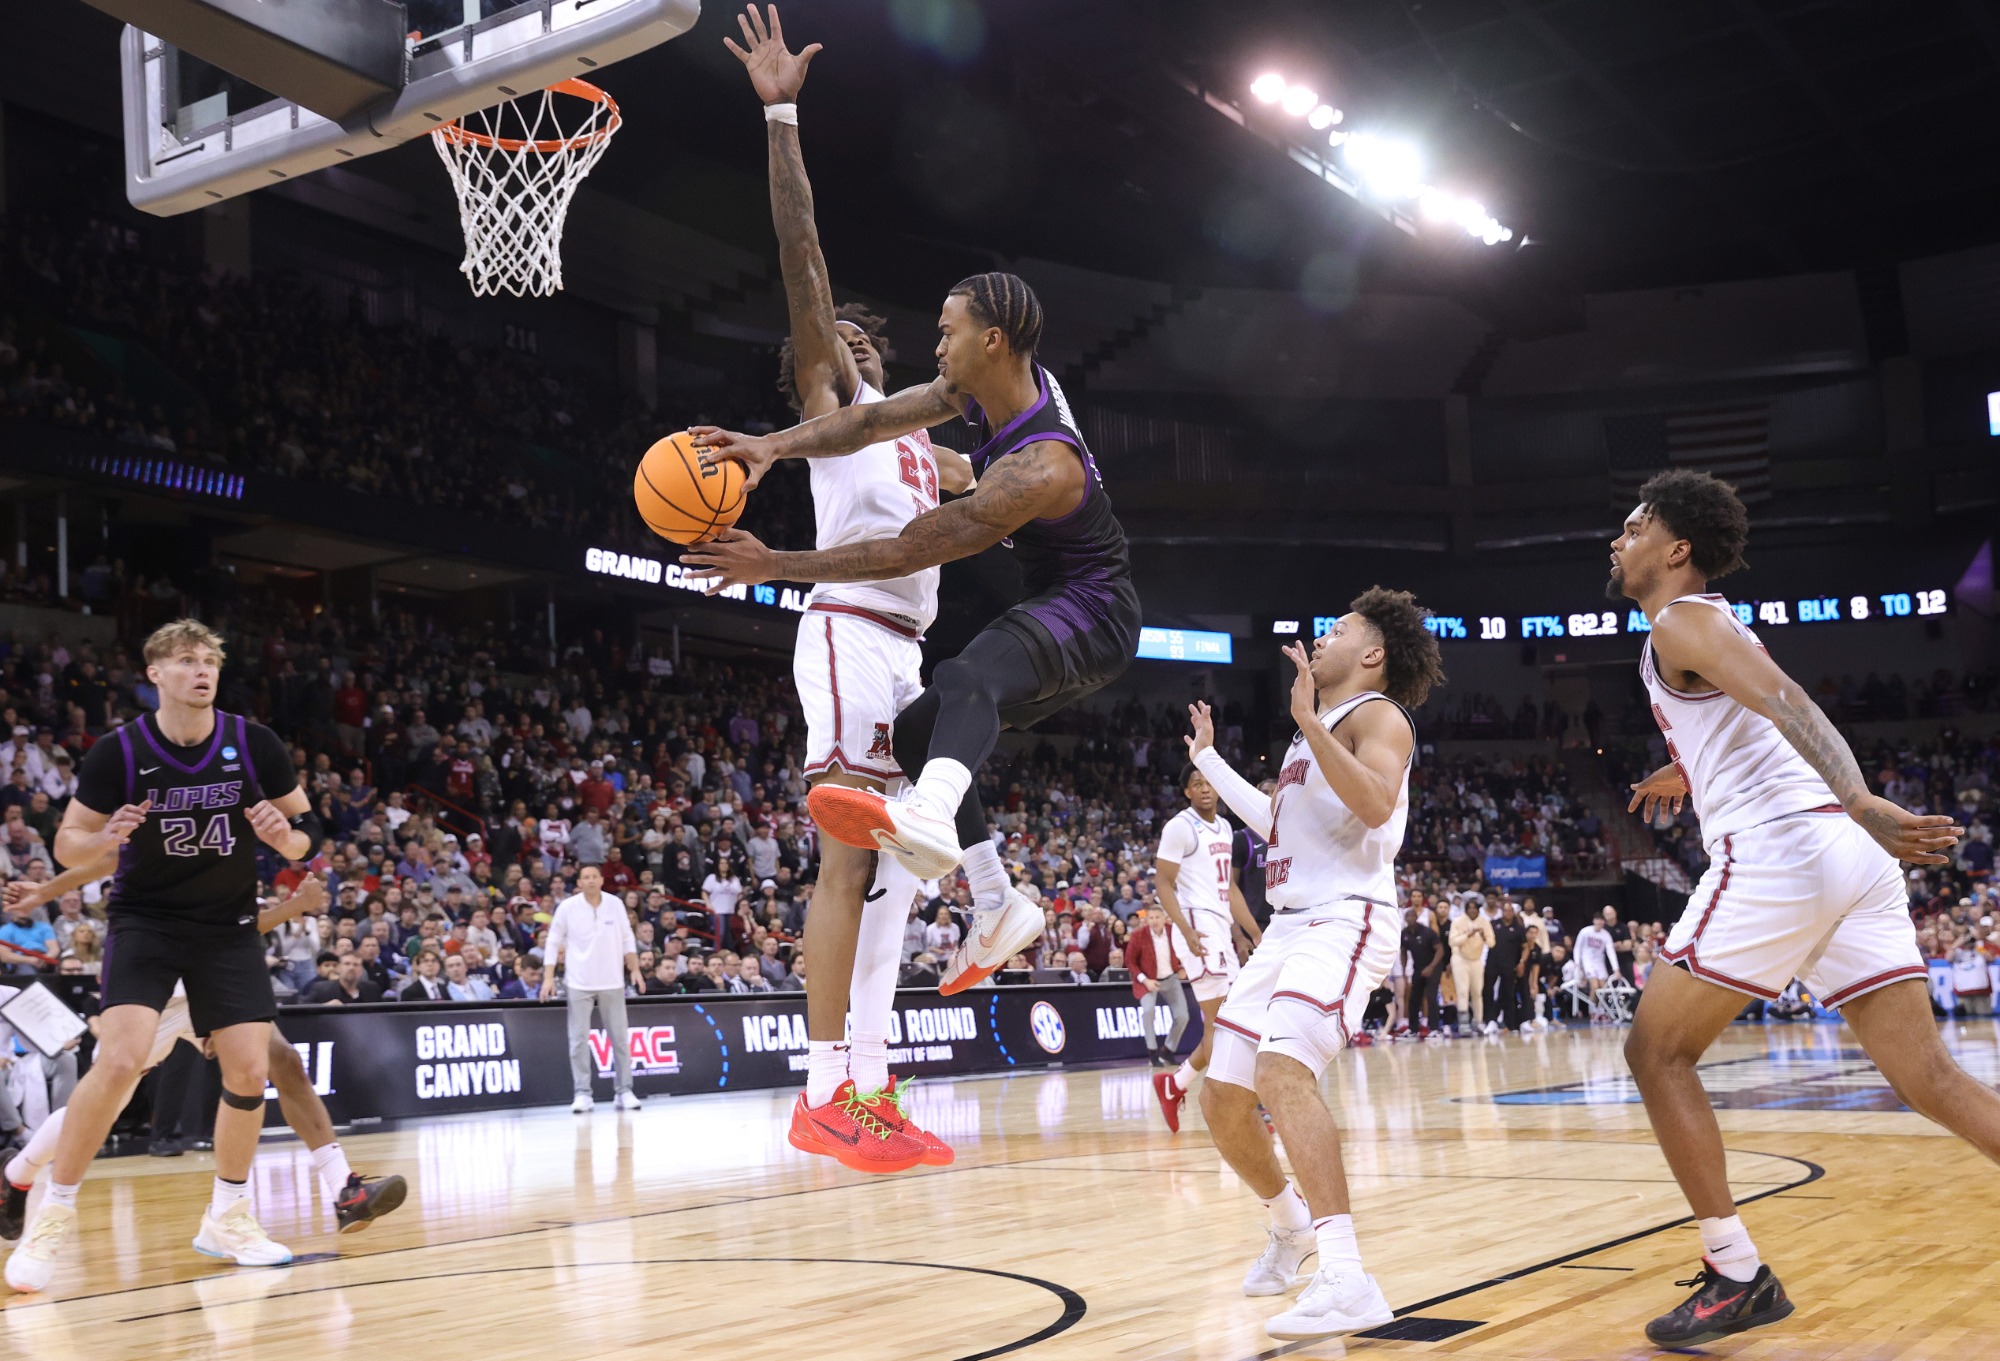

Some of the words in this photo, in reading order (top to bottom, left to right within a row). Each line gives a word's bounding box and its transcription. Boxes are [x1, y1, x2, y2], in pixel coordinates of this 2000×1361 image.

[895, 440, 938, 506] 23
[584, 547, 662, 584] GRAND
[753, 584, 777, 606] VS
[1480, 616, 1506, 640] 10
[1521, 615, 1565, 638] FT%
[1568, 611, 1618, 637] 62.2
[1759, 601, 1789, 625] 41
[1797, 598, 1840, 622] BLK
[1850, 596, 1868, 620] 8
[1880, 593, 1911, 616] TO
[1916, 589, 1947, 615] 12
[148, 780, 243, 813] LOPES
[160, 813, 236, 857] 24
[415, 1023, 506, 1060] GRAND
[588, 1026, 679, 1073] WAC
[742, 1014, 809, 1053] NCAA
[904, 1006, 978, 1043] ROUND
[1033, 1003, 1064, 1051] SEC
[415, 1059, 522, 1099] CANYON
